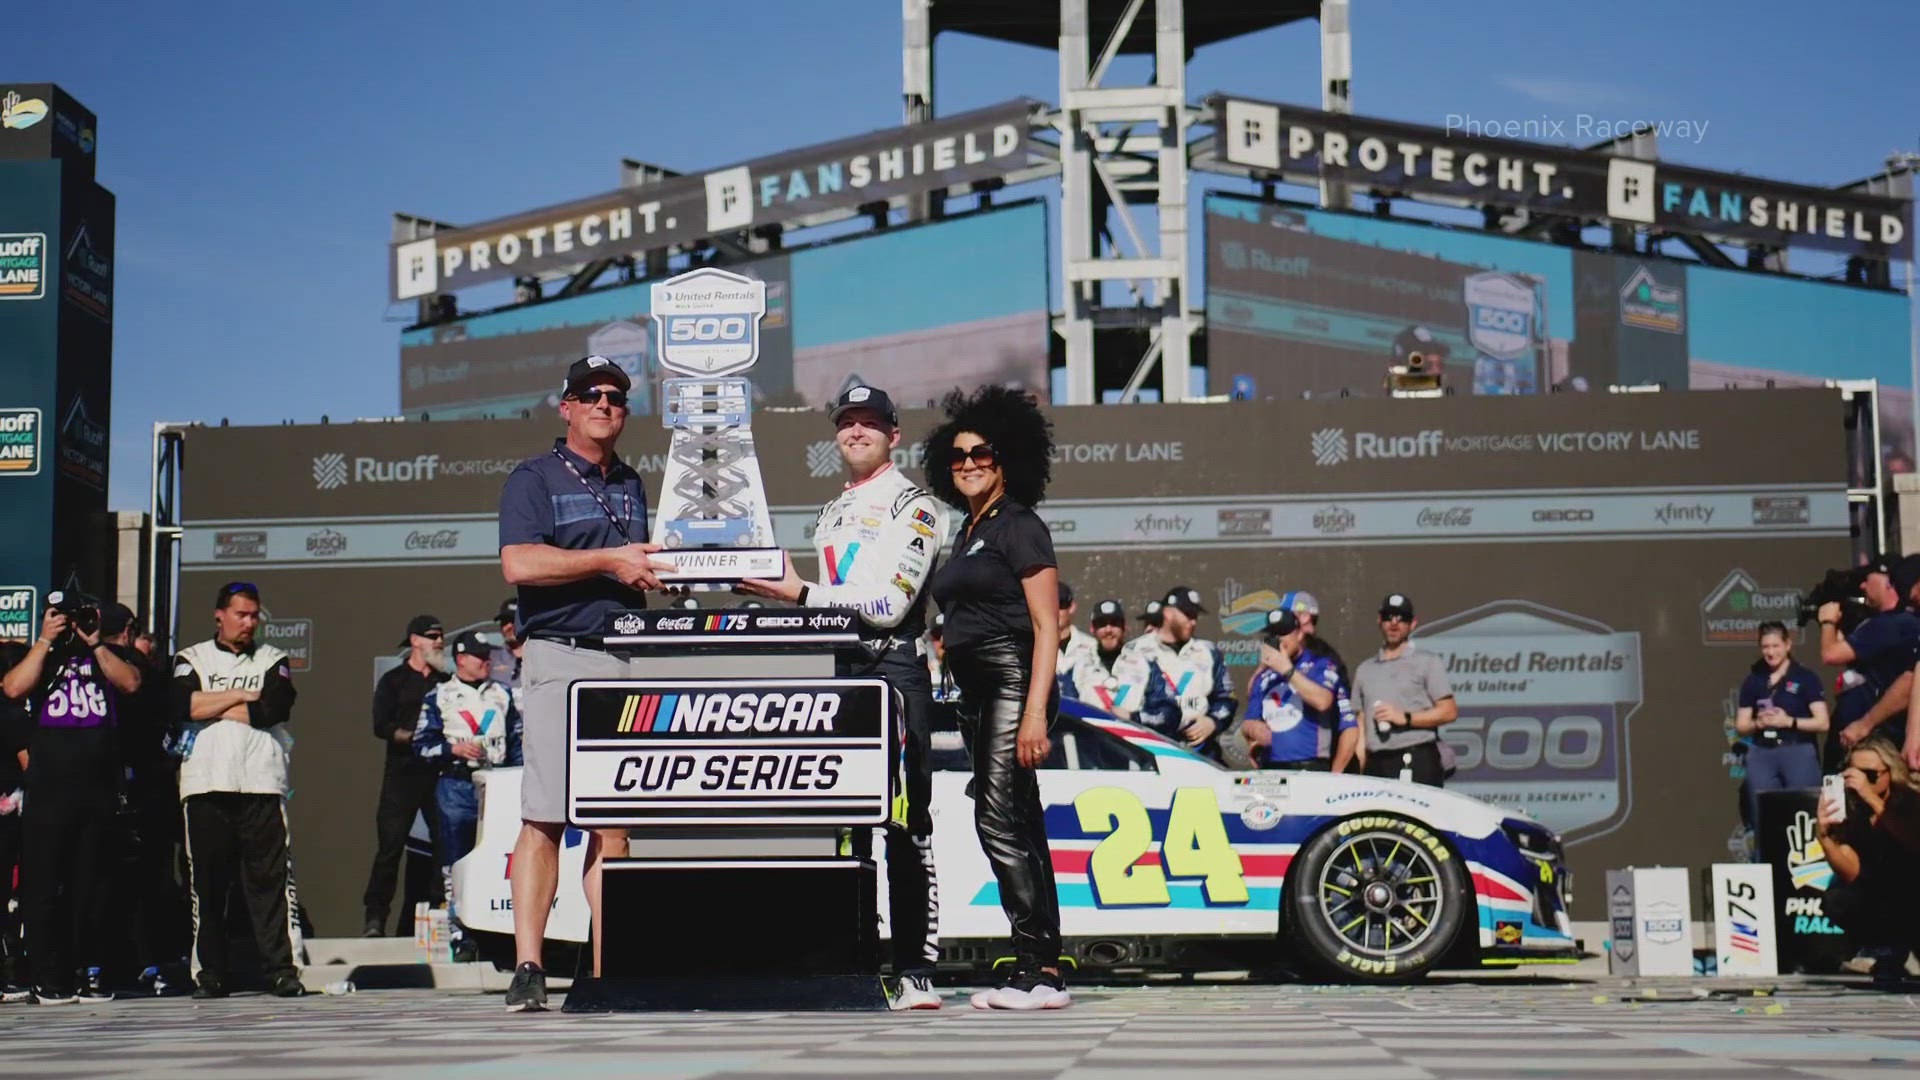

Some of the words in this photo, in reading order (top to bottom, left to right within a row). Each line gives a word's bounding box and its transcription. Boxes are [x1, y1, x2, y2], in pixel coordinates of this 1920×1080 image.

[759, 123, 1019, 207] FANSHIELD
[1288, 125, 1574, 199] PROTECHT.
[1662, 181, 1905, 246] FANSHIELD
[443, 201, 678, 277] PROTECHT.
[675, 292, 711, 301] United
[714, 290, 755, 300] Rentals
[670, 317, 746, 341] 500
[1126, 441, 1184, 462] LANE
[1355, 430, 1444, 459] Ruoff
[1445, 433, 1533, 451] MORTGAGE
[1537, 431, 1634, 451] VICTORY
[1640, 429, 1701, 450] LANE
[355, 455, 440, 483] Ruoff
[1134, 514, 1193, 536] xfinity
[1532, 509, 1594, 523] GEICO
[1654, 502, 1715, 526] xfinity
[306, 536, 347, 551] BUSCH
[674, 554, 738, 568] WINNER
[264, 622, 309, 639] Ruoff
[615, 618, 646, 631] BUSCH
[725, 614, 750, 631] 75
[756, 616, 804, 628] GEICO
[807, 614, 851, 630] xfinity
[1528, 650, 1625, 673] Rentals
[1450, 680, 1473, 692] ork
[1478, 679, 1528, 692] United
[669, 692, 842, 732] NASCAR
[1445, 715, 1603, 770] 500
[613, 754, 696, 793] CUP
[699, 754, 843, 791] SERIES
[1074, 786, 1249, 905] 24
[1337, 816, 1451, 862] GOODYEAR
